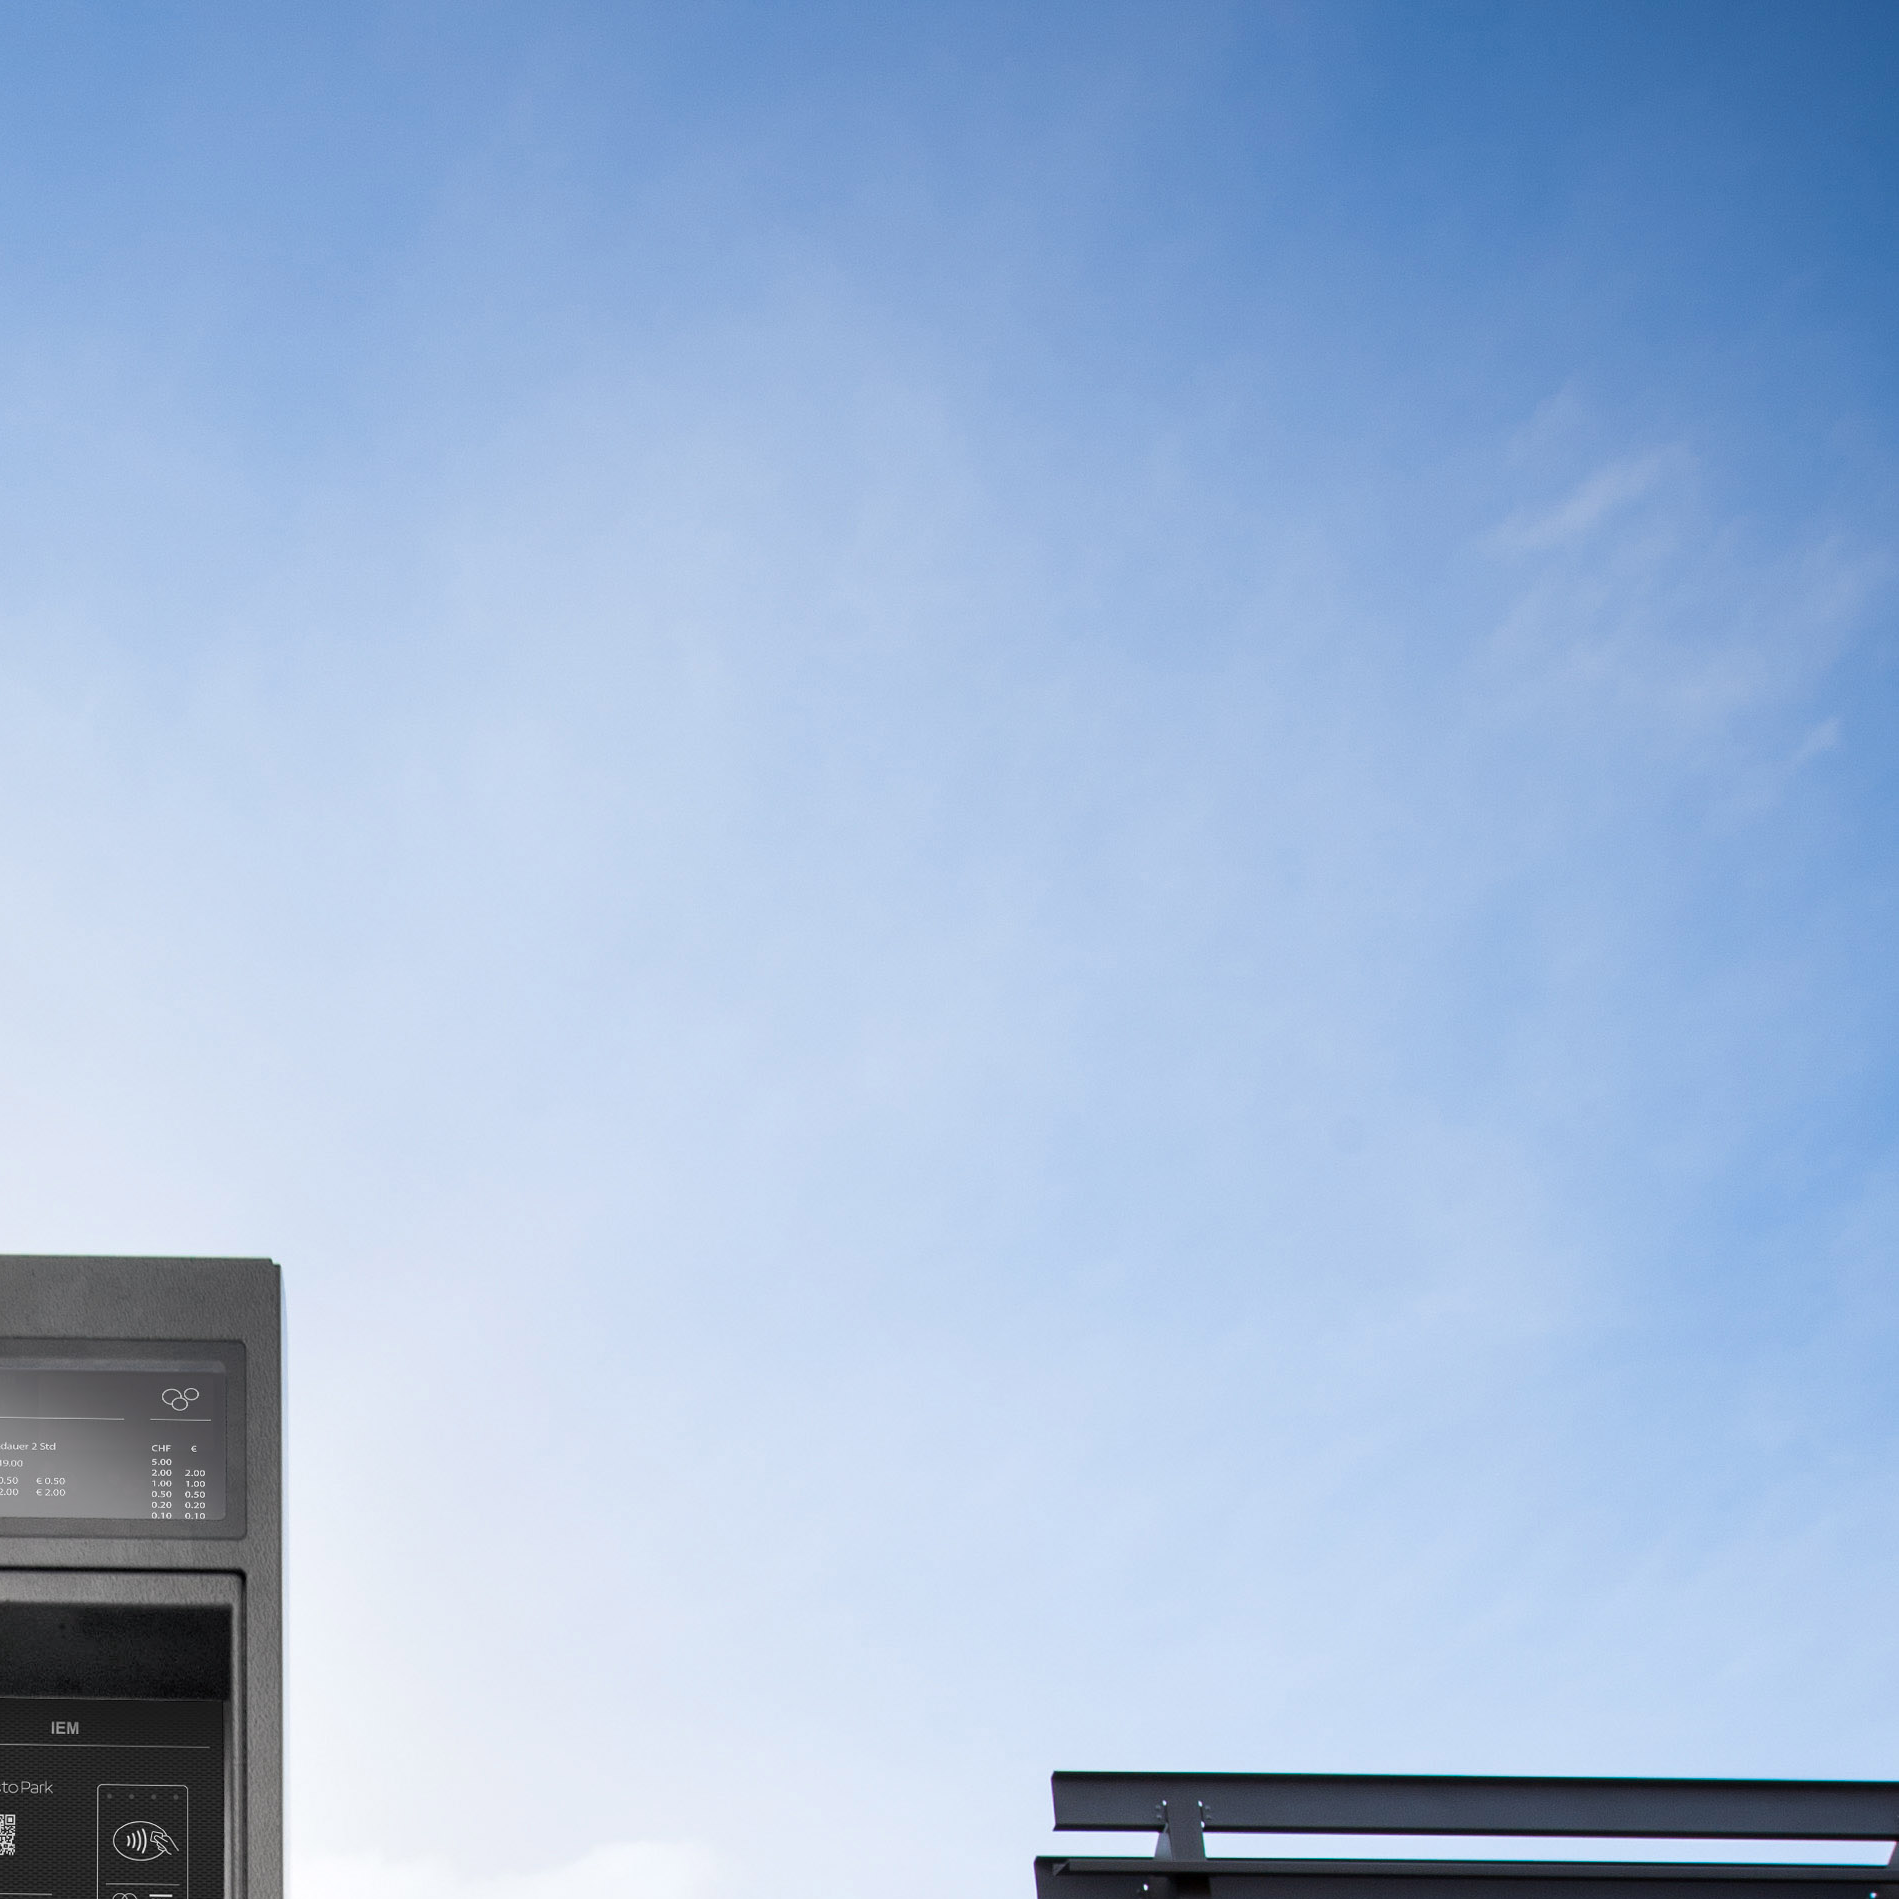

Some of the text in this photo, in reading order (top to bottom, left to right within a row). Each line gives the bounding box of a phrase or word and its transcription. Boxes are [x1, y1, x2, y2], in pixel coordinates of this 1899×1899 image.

[31, 1442, 38, 1451] 2
[39, 1442, 57, 1451] Std
[151, 1444, 198, 1453] CHF €
[151, 1458, 172, 1466] 5.00
[151, 1469, 206, 1477] 2.00 2.00
[44, 1477, 66, 1485] 0.50
[151, 1480, 206, 1488] 1.00 1.00
[44, 1488, 66, 1497] 2.00
[151, 1490, 206, 1499] 0.50 0.50
[151, 1501, 206, 1509] 0.20 0.20
[151, 1511, 206, 1520] 0.10 0.10
[50, 1720, 80, 1735] IEM
